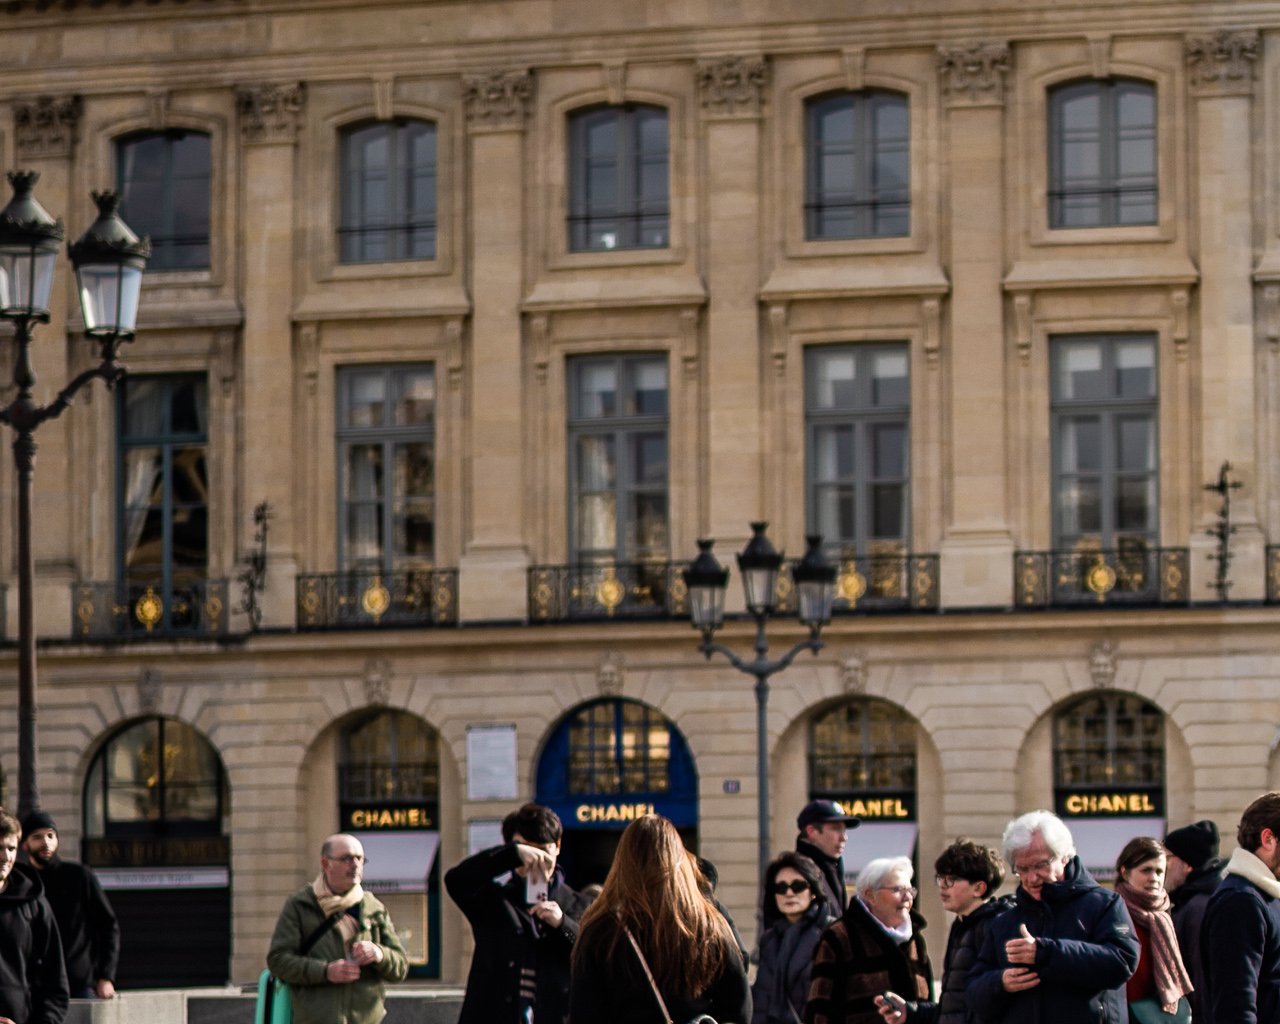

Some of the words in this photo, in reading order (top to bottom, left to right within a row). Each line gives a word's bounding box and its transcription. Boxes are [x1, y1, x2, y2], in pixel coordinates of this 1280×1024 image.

[839, 799, 909, 817] HANEL
[1065, 794, 1156, 813] CHANEL
[350, 808, 433, 828] CHANEL
